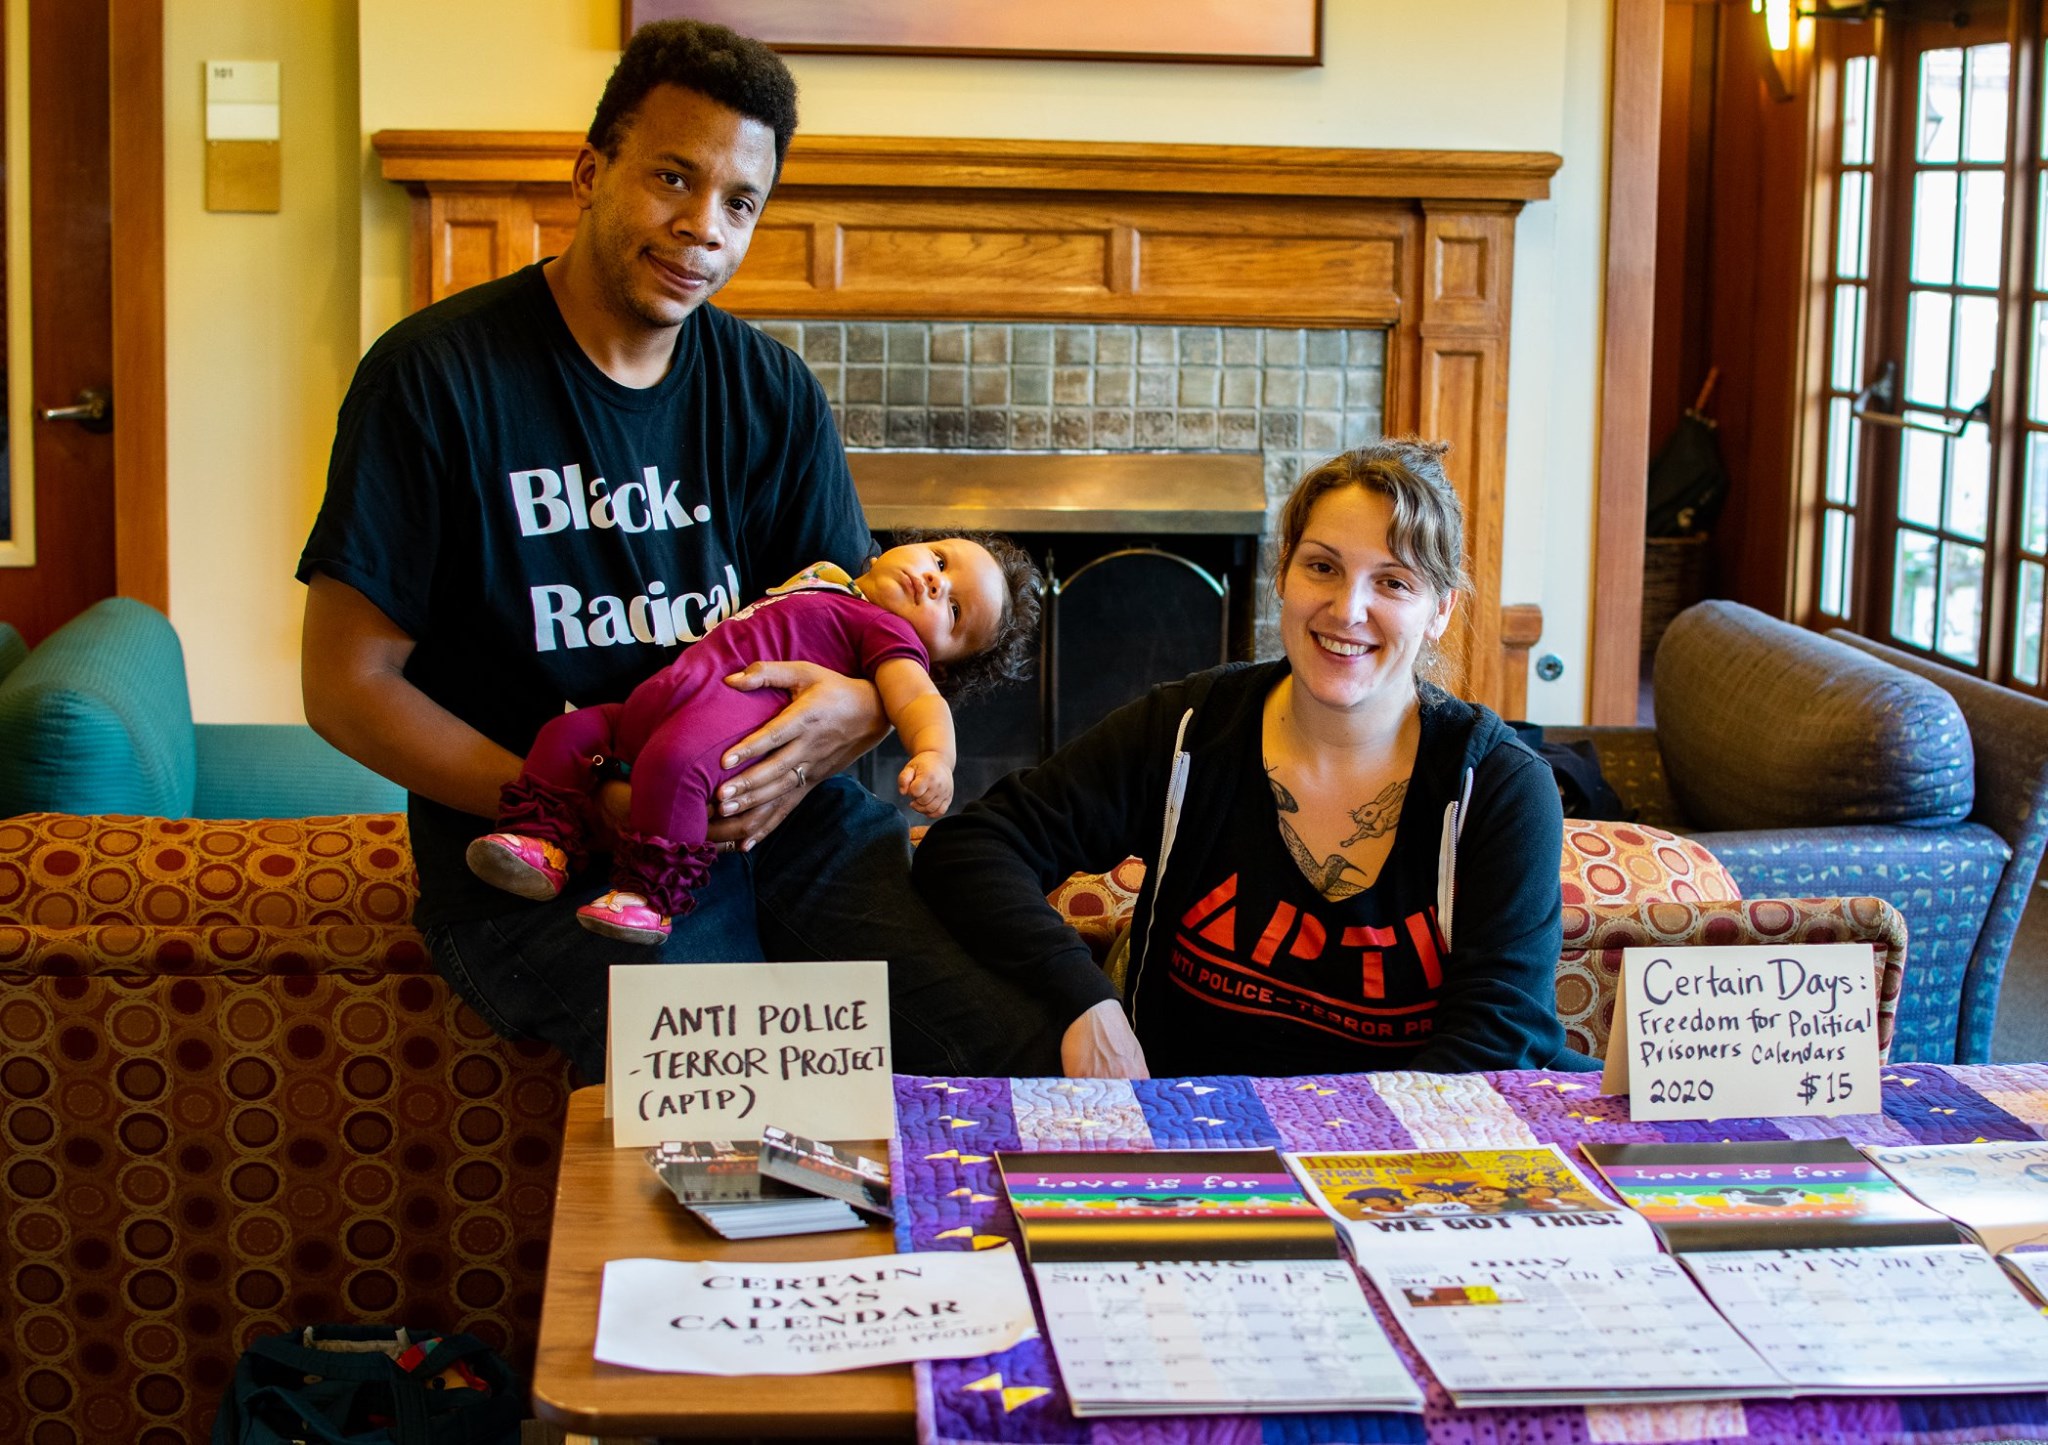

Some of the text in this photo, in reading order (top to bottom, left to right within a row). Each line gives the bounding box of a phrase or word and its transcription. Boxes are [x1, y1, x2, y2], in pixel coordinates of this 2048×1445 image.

[509, 464, 711, 537] Black.
[1171, 949, 1194, 979] NTI
[1643, 958, 1764, 1005] Certain
[649, 1000, 869, 1041] ANTI POLICE
[1638, 1006, 1872, 1038] Freedom for Political
[779, 1045, 886, 1081] PROJECT
[1640, 1039, 1742, 1067] Prisoners
[638, 1084, 757, 1121] (APTP)
[1649, 1071, 1854, 1106] 2020 $15
[1037, 1175, 1261, 1190] Love is for
[1635, 1165, 1848, 1181] Love is for
[1369, 1212, 1624, 1232] WE GOT THIS!
[702, 1267, 924, 1290] CERTAIN
[751, 1289, 882, 1310] DAYS
[670, 1300, 962, 1332] CALENDAR
